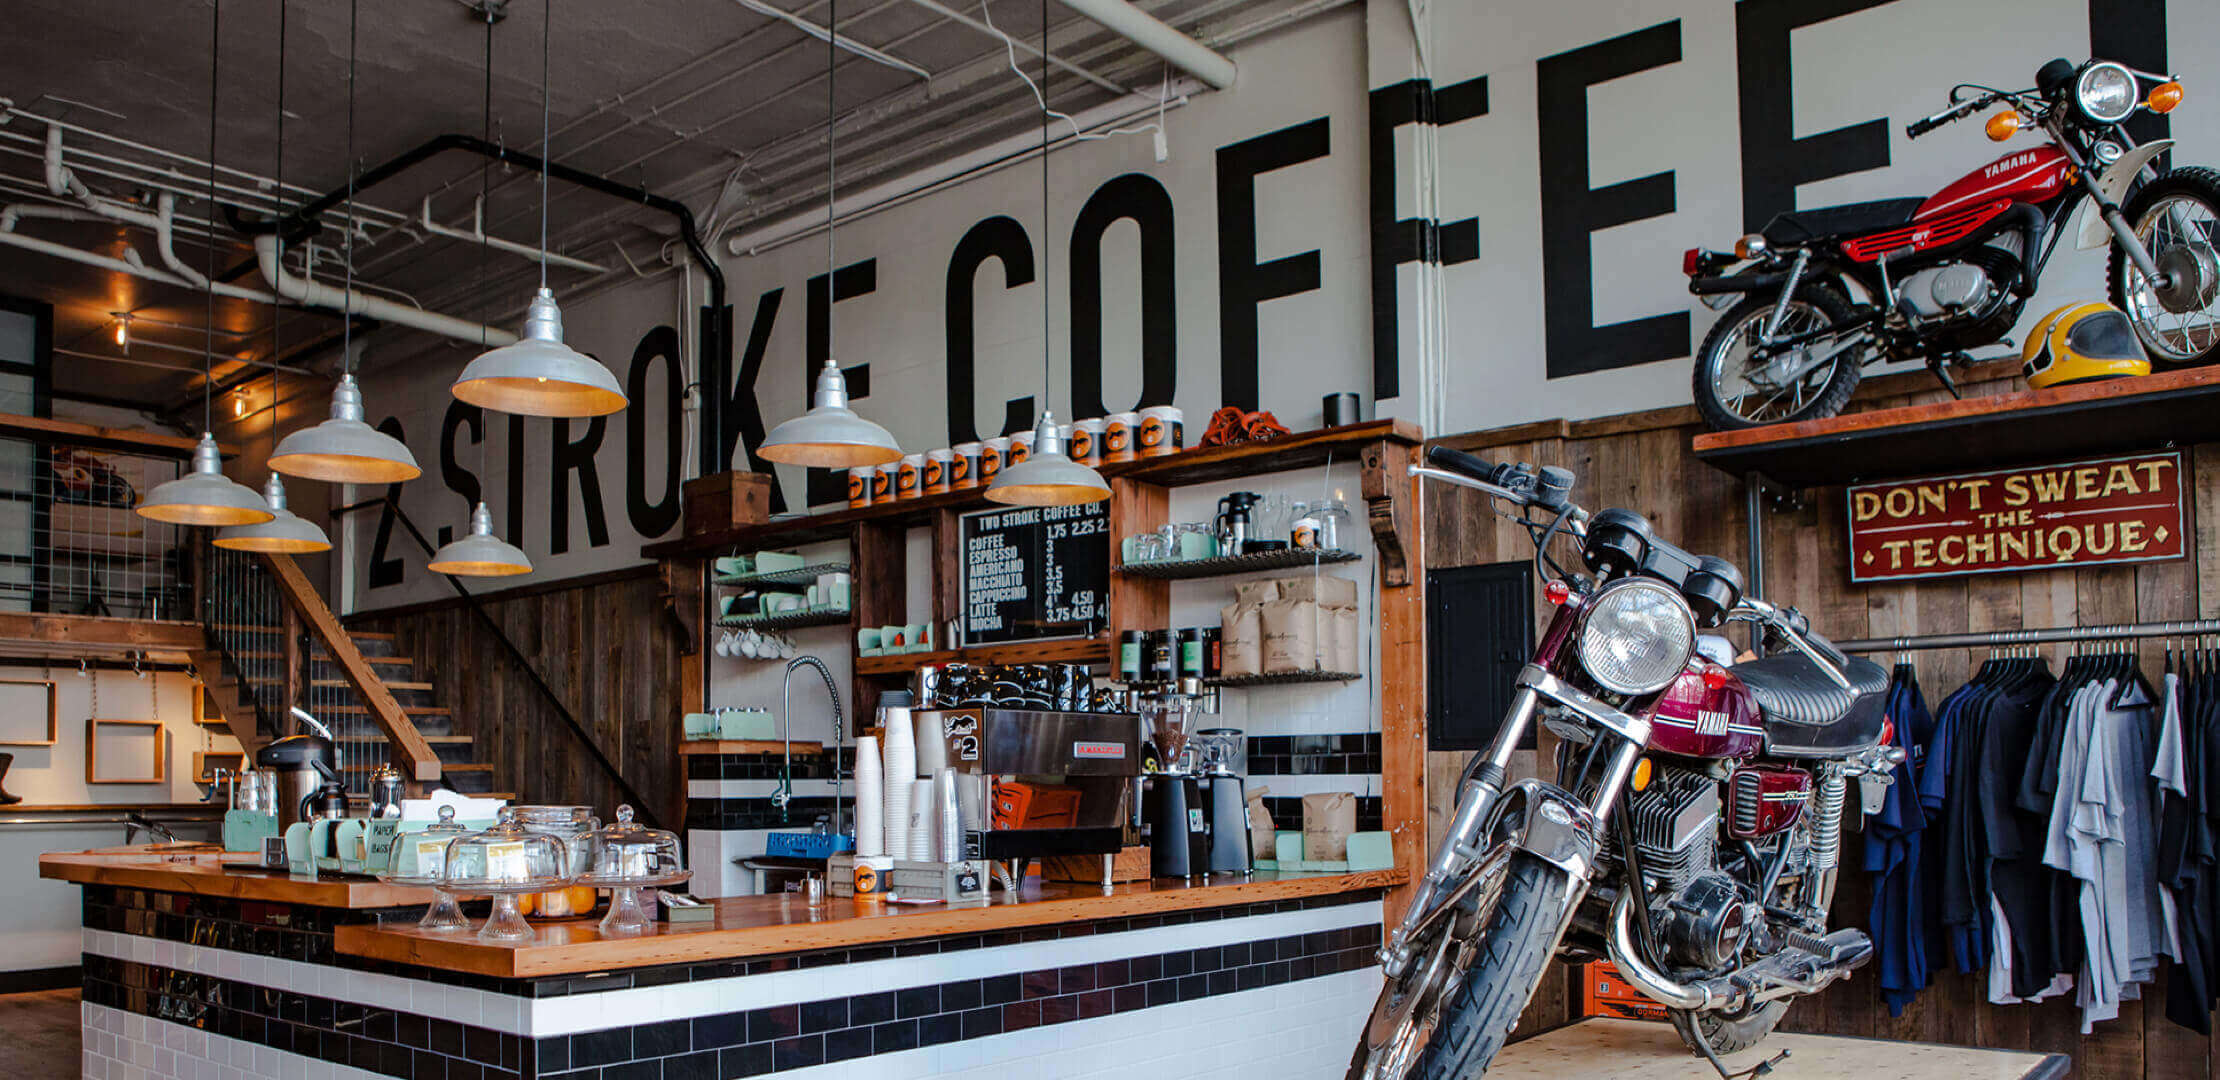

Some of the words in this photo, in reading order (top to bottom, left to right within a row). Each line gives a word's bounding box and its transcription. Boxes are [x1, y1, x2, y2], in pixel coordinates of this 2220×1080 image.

[1984, 151, 2037, 179] YAMAHA
[945, 0, 1902, 447] COFFEE
[1854, 479, 1993, 522] DON'T
[2003, 459, 2174, 507] SWEAT
[979, 515, 1000, 531] TWO
[1002, 509, 1041, 527] STROKE
[1043, 504, 1081, 521] COFFEE
[1978, 508, 2035, 530] THE
[969, 533, 1005, 551] COFFEE
[1047, 523, 1067, 539] 1.75
[1071, 520, 1095, 536] 2.25
[1880, 519, 2151, 570] TECHNIQUE
[969, 546, 1018, 565] ESPRESSO
[1046, 539, 1054, 553] 3
[969, 558, 1024, 578] AMERICANO
[1046, 553, 1054, 567] 3
[969, 573, 1023, 591] MACCHIATO
[969, 585, 1027, 604] CAPPUCCINO
[969, 602, 998, 618] LATTE
[1071, 590, 1094, 605] 4.50
[970, 616, 1003, 632] MOCHA
[1047, 607, 1070, 623] 3.75
[1071, 605, 1094, 620] 4.50
[1695, 709, 1730, 736] YAMAHA
